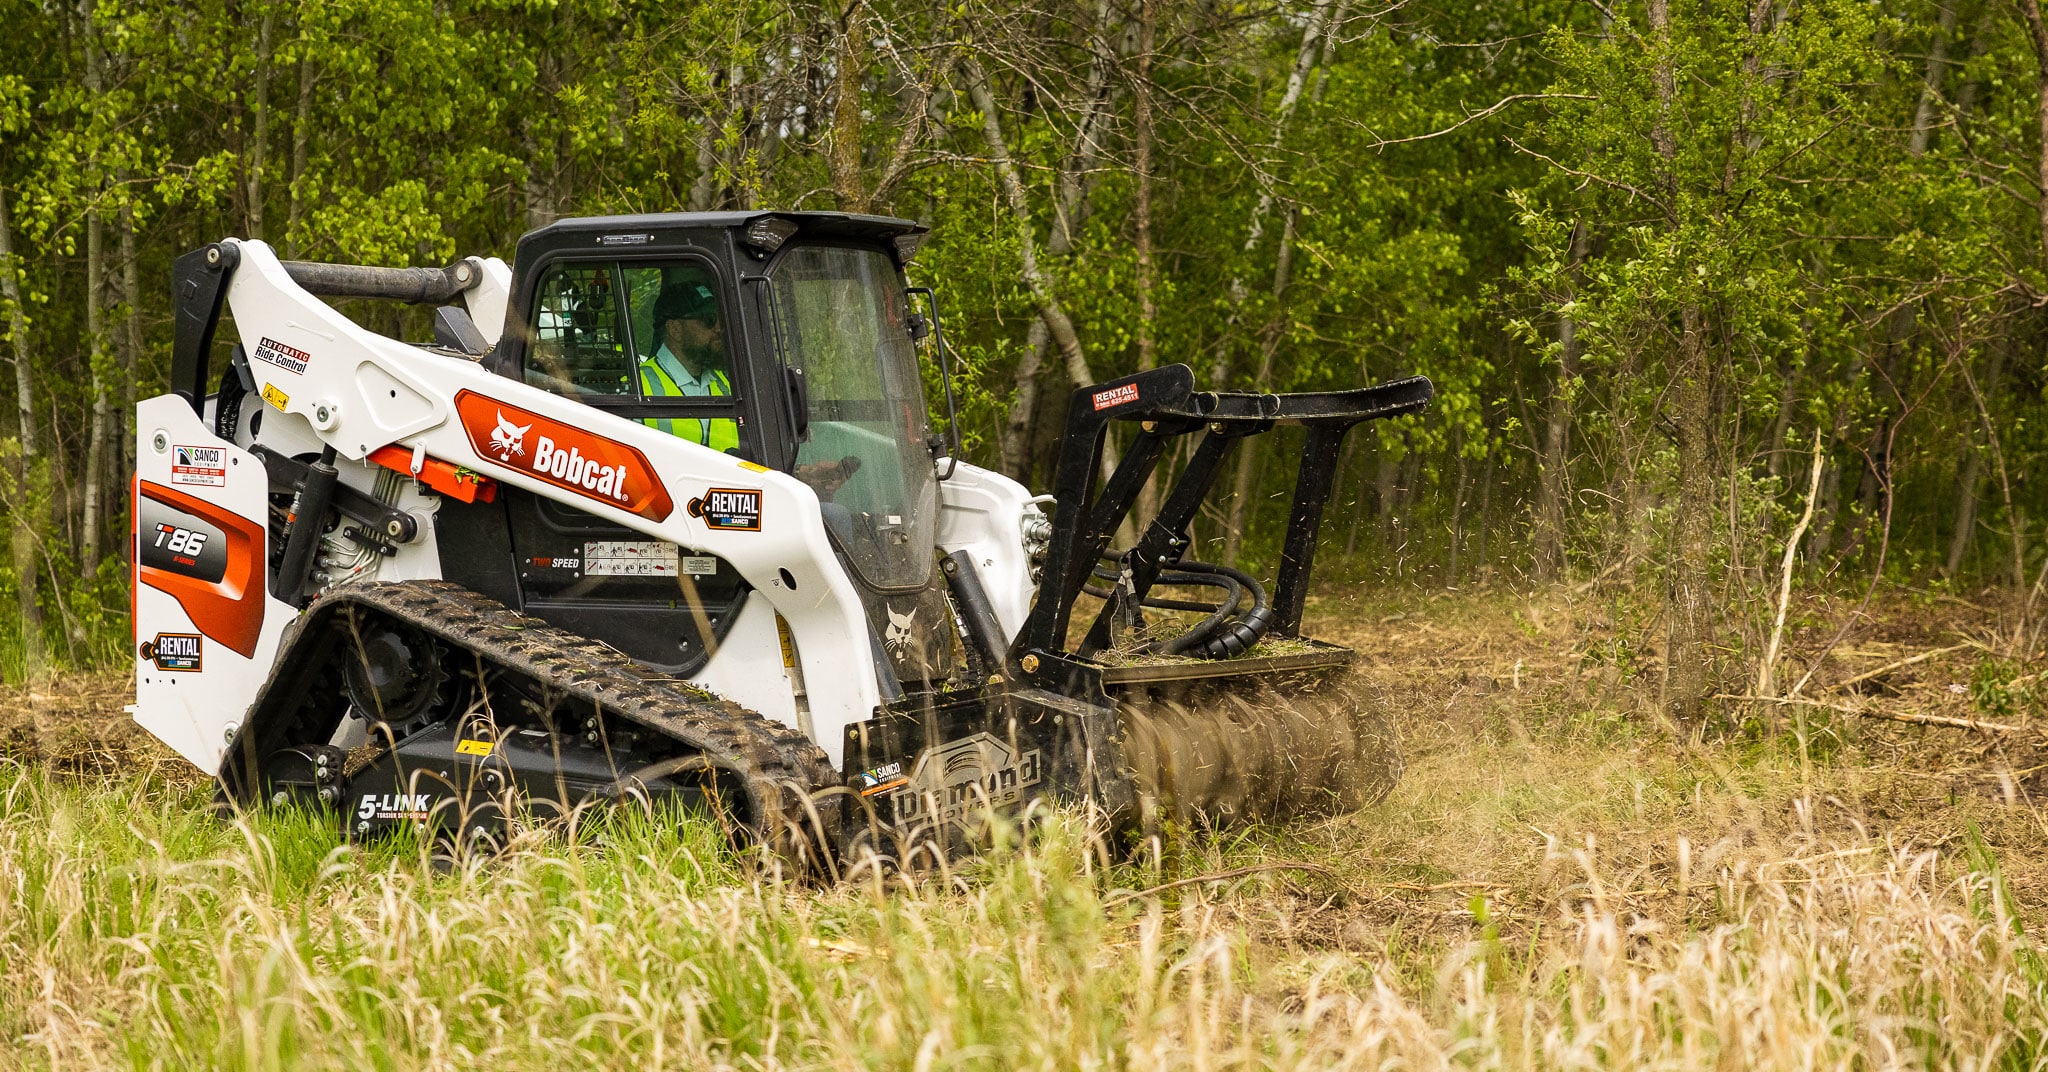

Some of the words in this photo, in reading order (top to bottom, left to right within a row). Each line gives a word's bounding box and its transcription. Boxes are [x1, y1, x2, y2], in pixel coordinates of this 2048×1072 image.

[255, 346, 275, 361] Ride
[275, 354, 307, 373] Control
[261, 338, 309, 362] AUTOMATIC
[1096, 386, 1135, 403] RENTAL
[194, 448, 219, 462] SANCO
[533, 435, 627, 500] Bobcat
[711, 492, 759, 514] RENTAL
[153, 523, 208, 557] T86
[532, 557, 551, 568] TWO
[551, 557, 580, 569] SPEED
[160, 636, 200, 656] RENTAL
[876, 762, 901, 779] SANCO
[358, 794, 432, 820] 5-LINK
